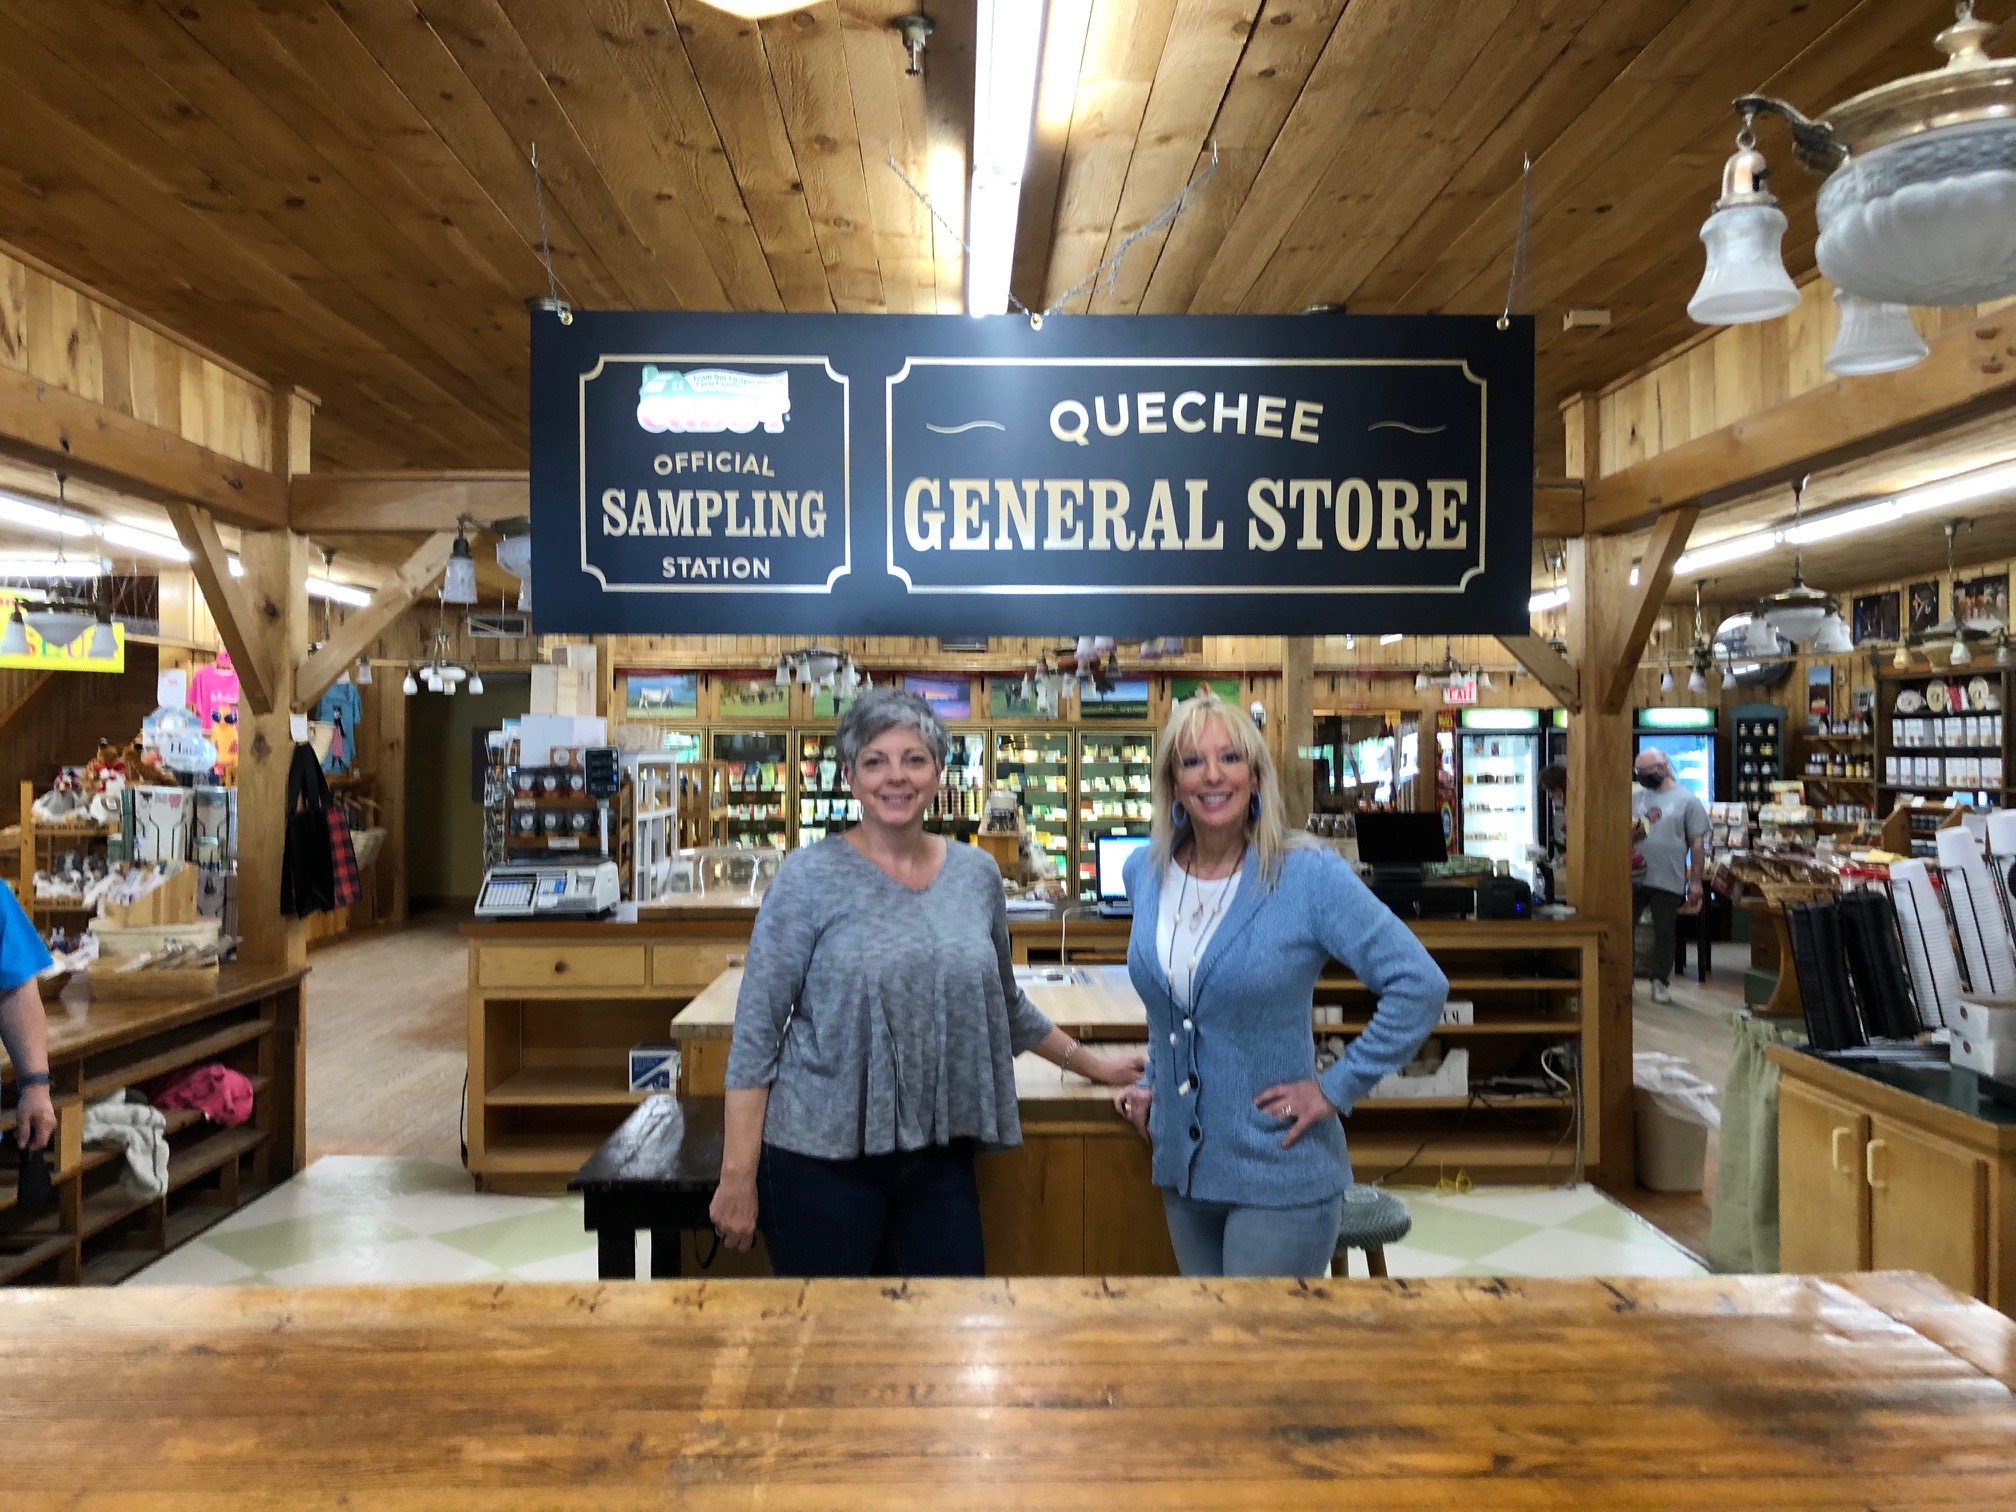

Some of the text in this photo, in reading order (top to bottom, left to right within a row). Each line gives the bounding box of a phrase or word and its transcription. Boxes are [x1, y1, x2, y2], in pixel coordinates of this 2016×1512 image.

[1049, 390, 1324, 446] QUECHEE
[653, 450, 776, 478] OFFICIAL
[601, 487, 828, 539] SAMPLING
[903, 476, 1468, 553] GENERAL STORE
[661, 555, 771, 579] STATION
